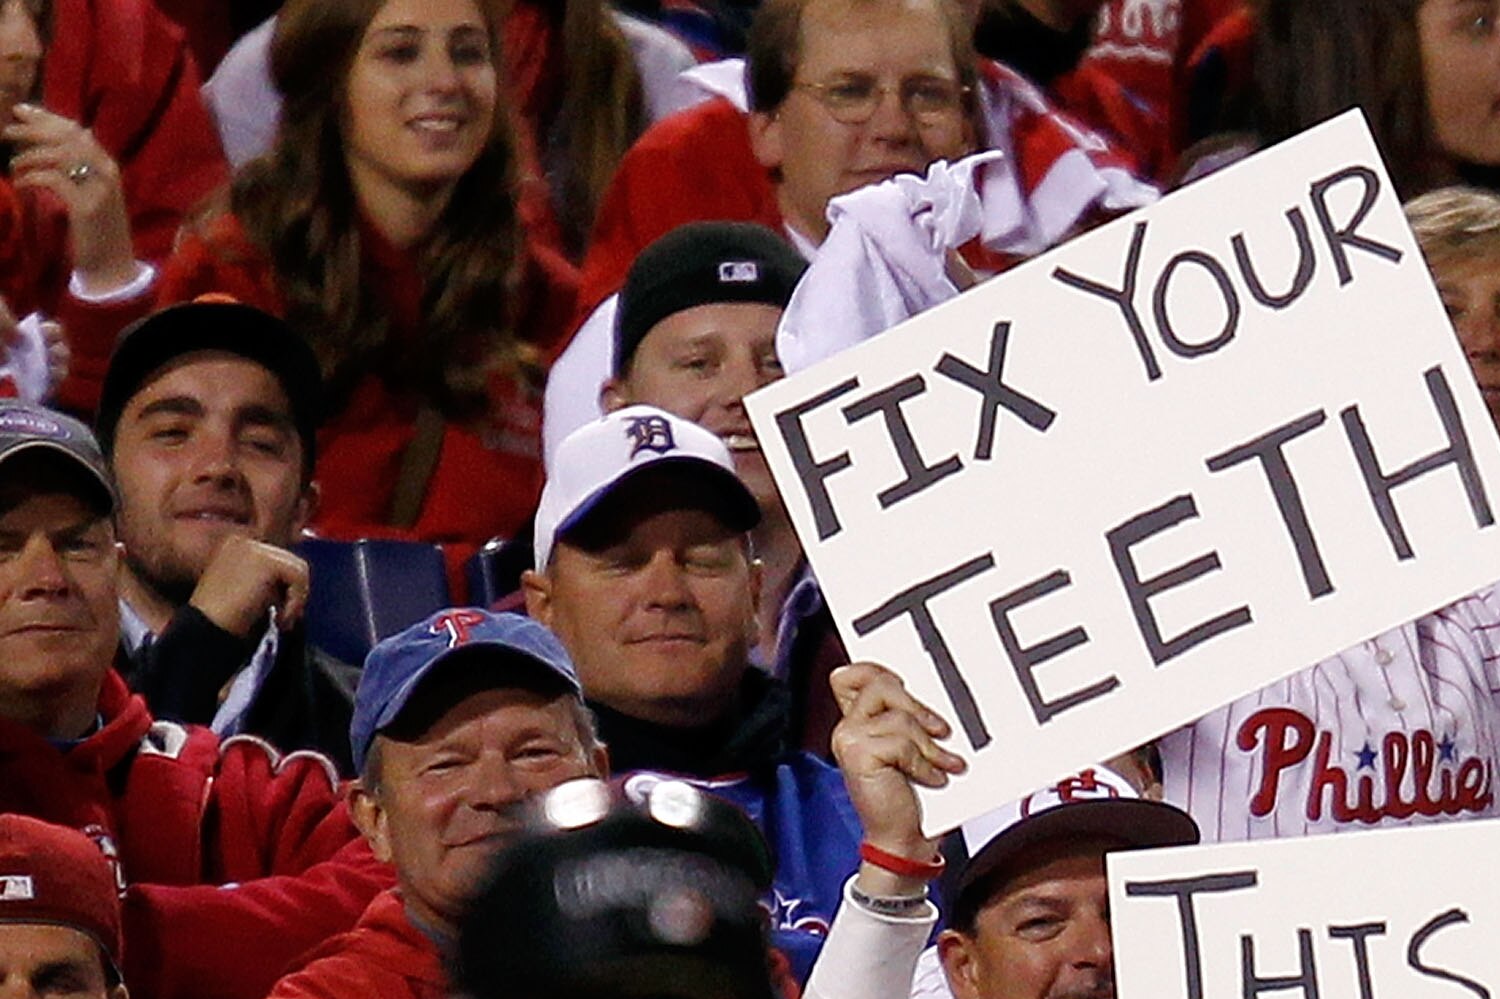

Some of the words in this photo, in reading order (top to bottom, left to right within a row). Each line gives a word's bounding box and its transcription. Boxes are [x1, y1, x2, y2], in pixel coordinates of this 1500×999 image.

[775, 322, 1056, 541] FIX
[1052, 166, 1402, 381] YOUR
[852, 365, 1495, 751] TEETH
[1236, 707, 1494, 824] Phillie
